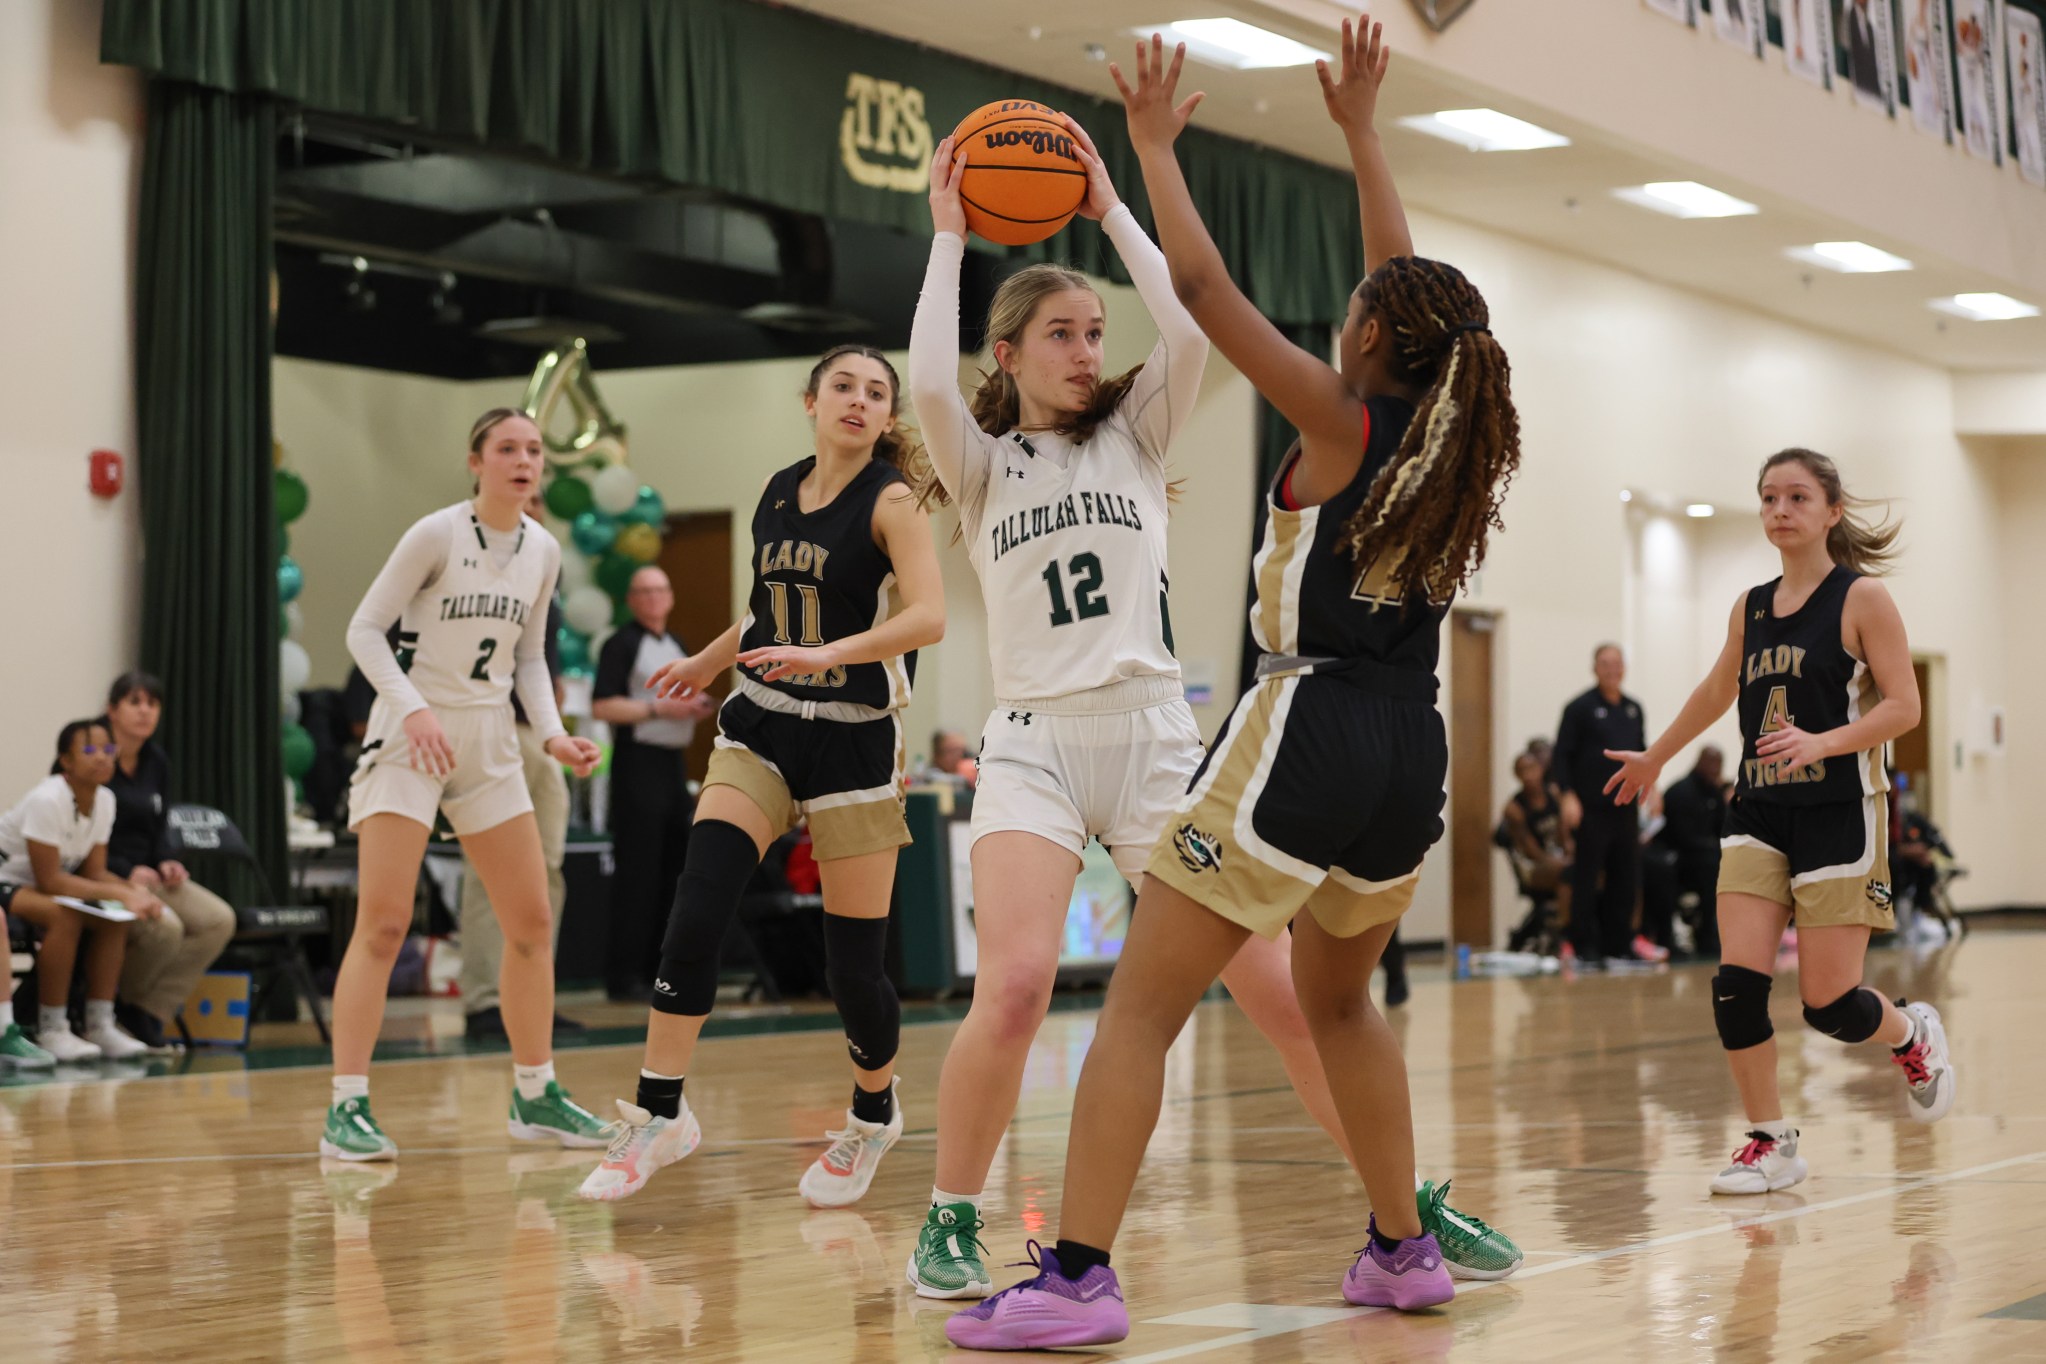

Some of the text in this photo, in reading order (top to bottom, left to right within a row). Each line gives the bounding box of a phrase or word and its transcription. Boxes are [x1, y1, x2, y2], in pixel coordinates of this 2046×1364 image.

[985, 130, 1077, 162] Wilson
[991, 491, 1143, 562] TALLULAH FALLS
[760, 539, 829, 581] LADY
[440, 594, 509, 621] TALLULAH
[1041, 551, 1111, 628] 12
[764, 581, 824, 646] 11
[470, 637, 497, 681] 2
[1746, 644, 1806, 686] LADY
[1759, 685, 1795, 735] 4
